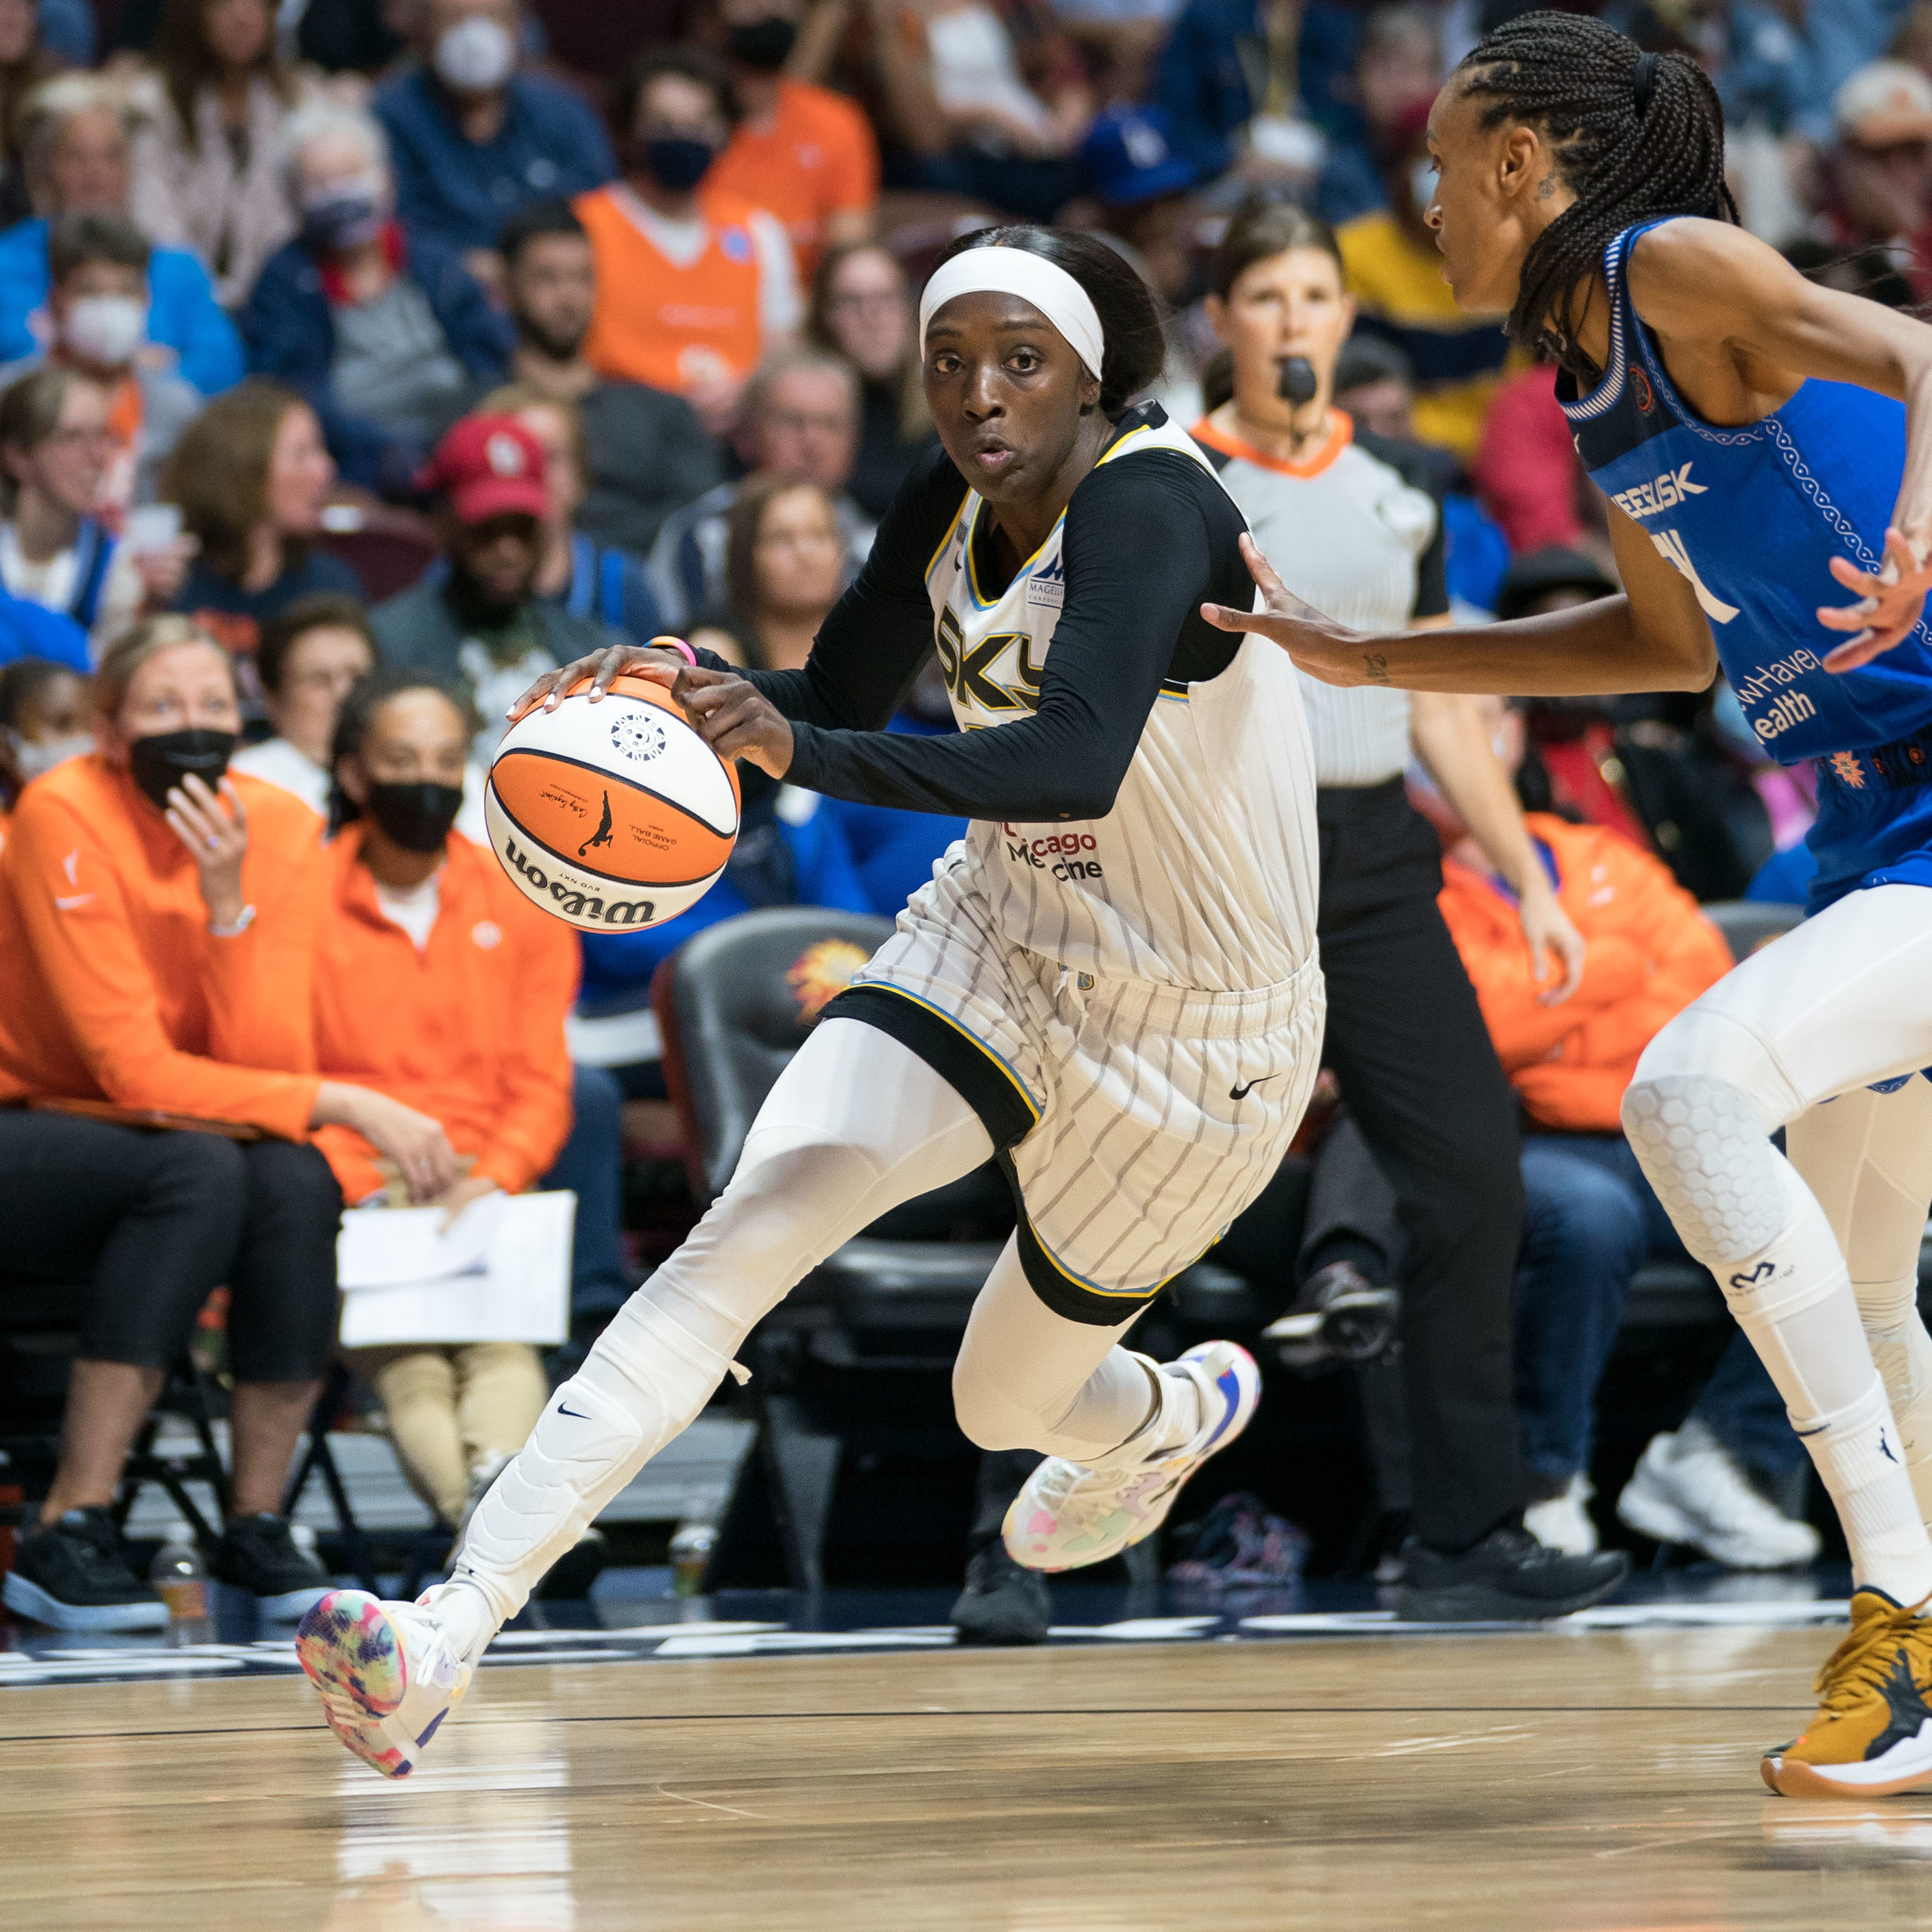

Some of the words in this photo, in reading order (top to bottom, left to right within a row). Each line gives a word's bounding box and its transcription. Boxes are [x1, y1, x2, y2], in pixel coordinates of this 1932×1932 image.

[1611, 461, 1709, 519] EESUSK
[1735, 647, 1820, 712] wHave
[629, 825, 651, 837] BALL
[652, 833, 677, 844] GAME
[632, 835, 669, 851] OFFICIAL
[1006, 841, 1102, 881] Mecine
[558, 872, 577, 884] NXT
